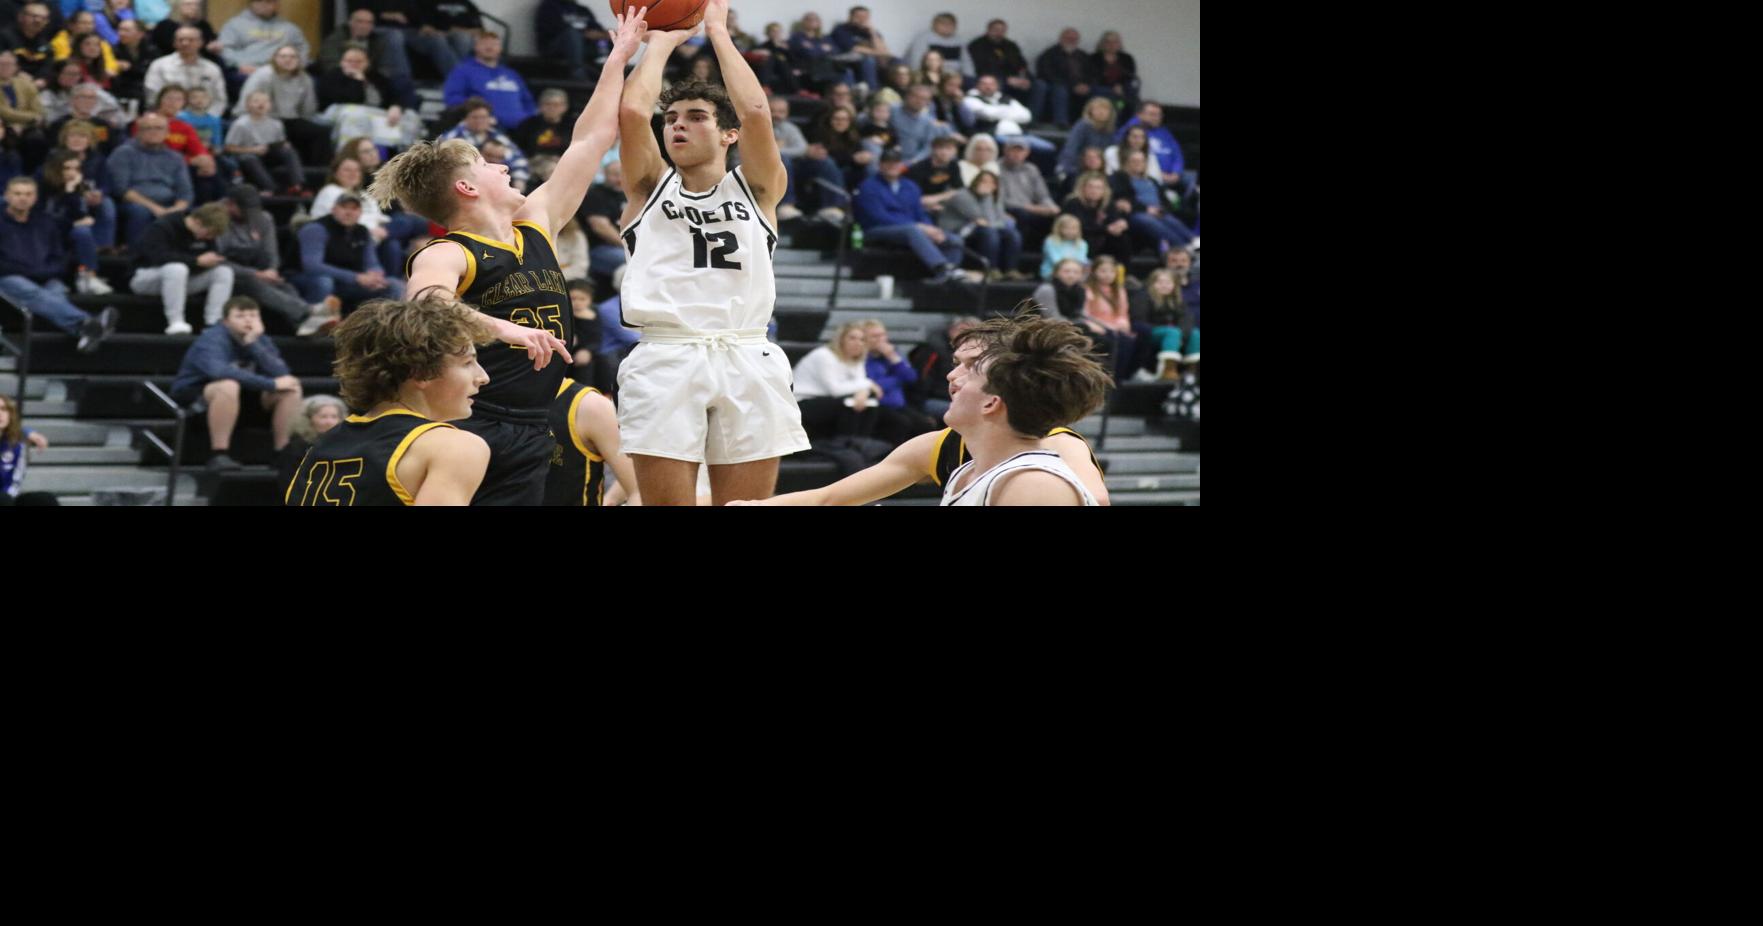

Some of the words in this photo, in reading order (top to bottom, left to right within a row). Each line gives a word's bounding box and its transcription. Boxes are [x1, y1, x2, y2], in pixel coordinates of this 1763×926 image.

[661, 200, 750, 225] CDETS
[689, 225, 742, 270] 12
[481, 272, 535, 306] CLEAR
[528, 269, 567, 295] LAK
[301, 457, 363, 506] 15
